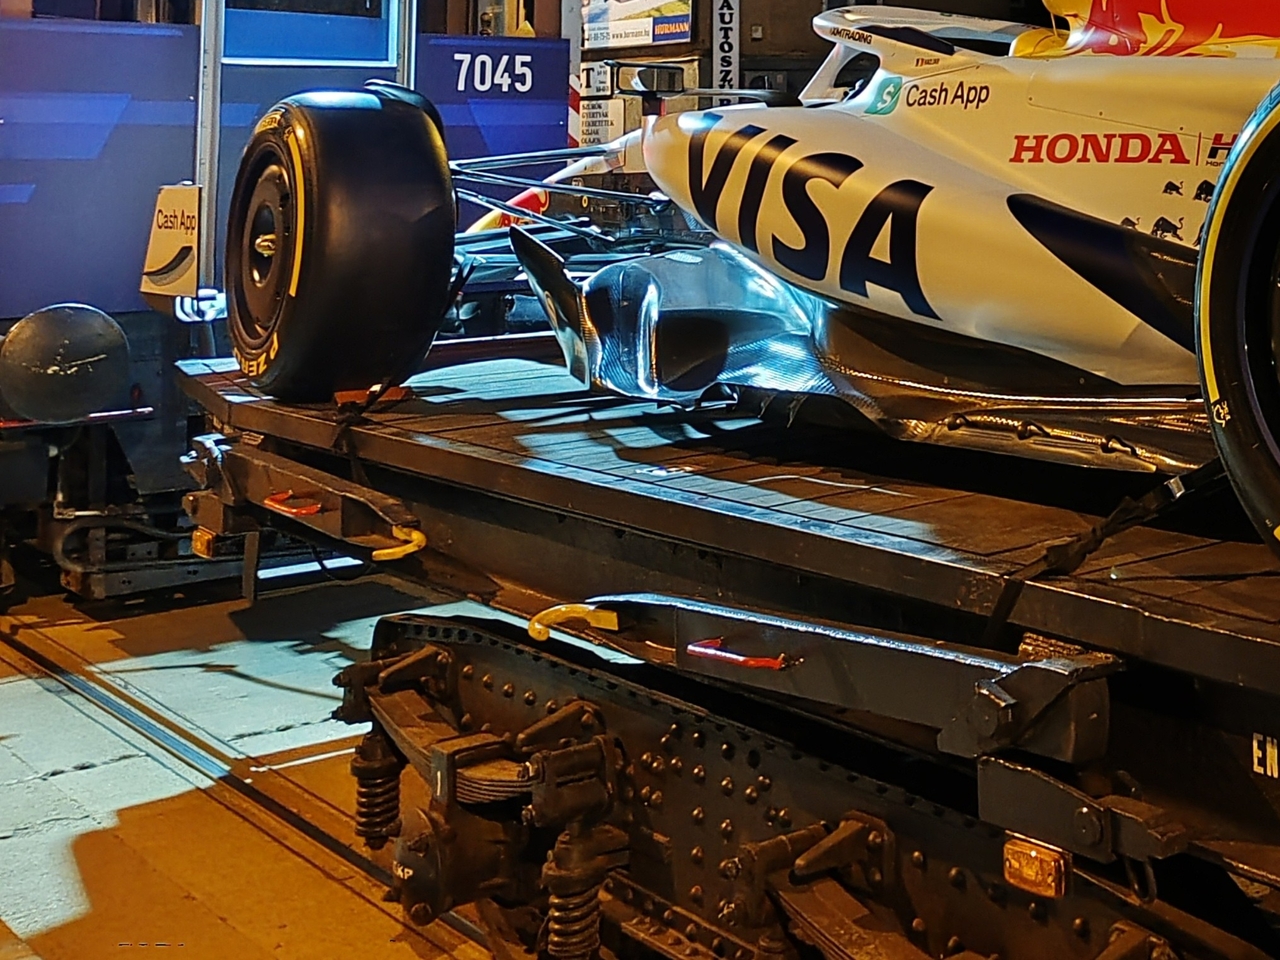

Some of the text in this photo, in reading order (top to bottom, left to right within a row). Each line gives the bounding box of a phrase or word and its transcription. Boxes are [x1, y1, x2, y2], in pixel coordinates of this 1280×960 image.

[453, 53, 533, 93] 7045
[906, 82, 949, 107] Cash
[950, 80, 990, 110] App
[1008, 133, 1191, 165] HONDA
[156, 209, 196, 236] Cash App
[688, 111, 944, 322] VISA
[232, 346, 267, 377] ZERO
